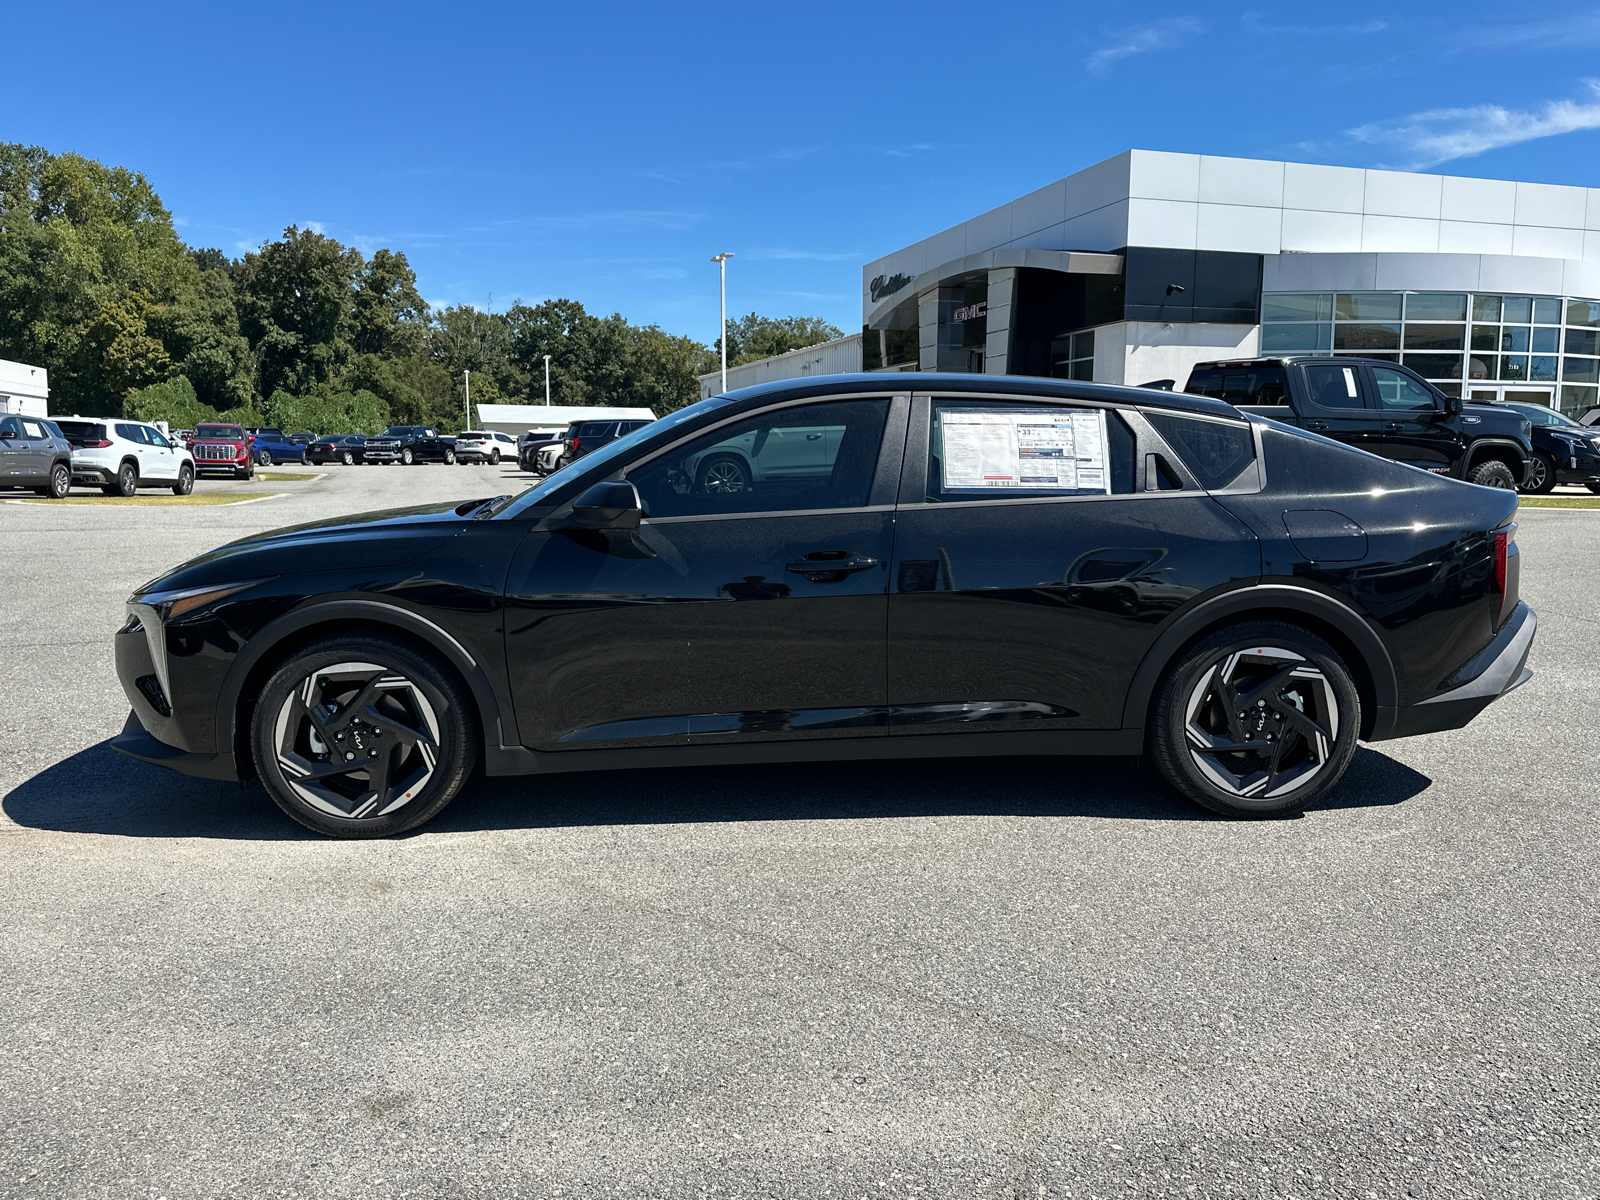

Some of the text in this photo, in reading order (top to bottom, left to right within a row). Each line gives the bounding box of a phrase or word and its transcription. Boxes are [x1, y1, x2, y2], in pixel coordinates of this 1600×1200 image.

[954, 301, 987, 322] GMC
[1022, 428, 1031, 436] 33
[340, 821, 395, 835] KUMHO
